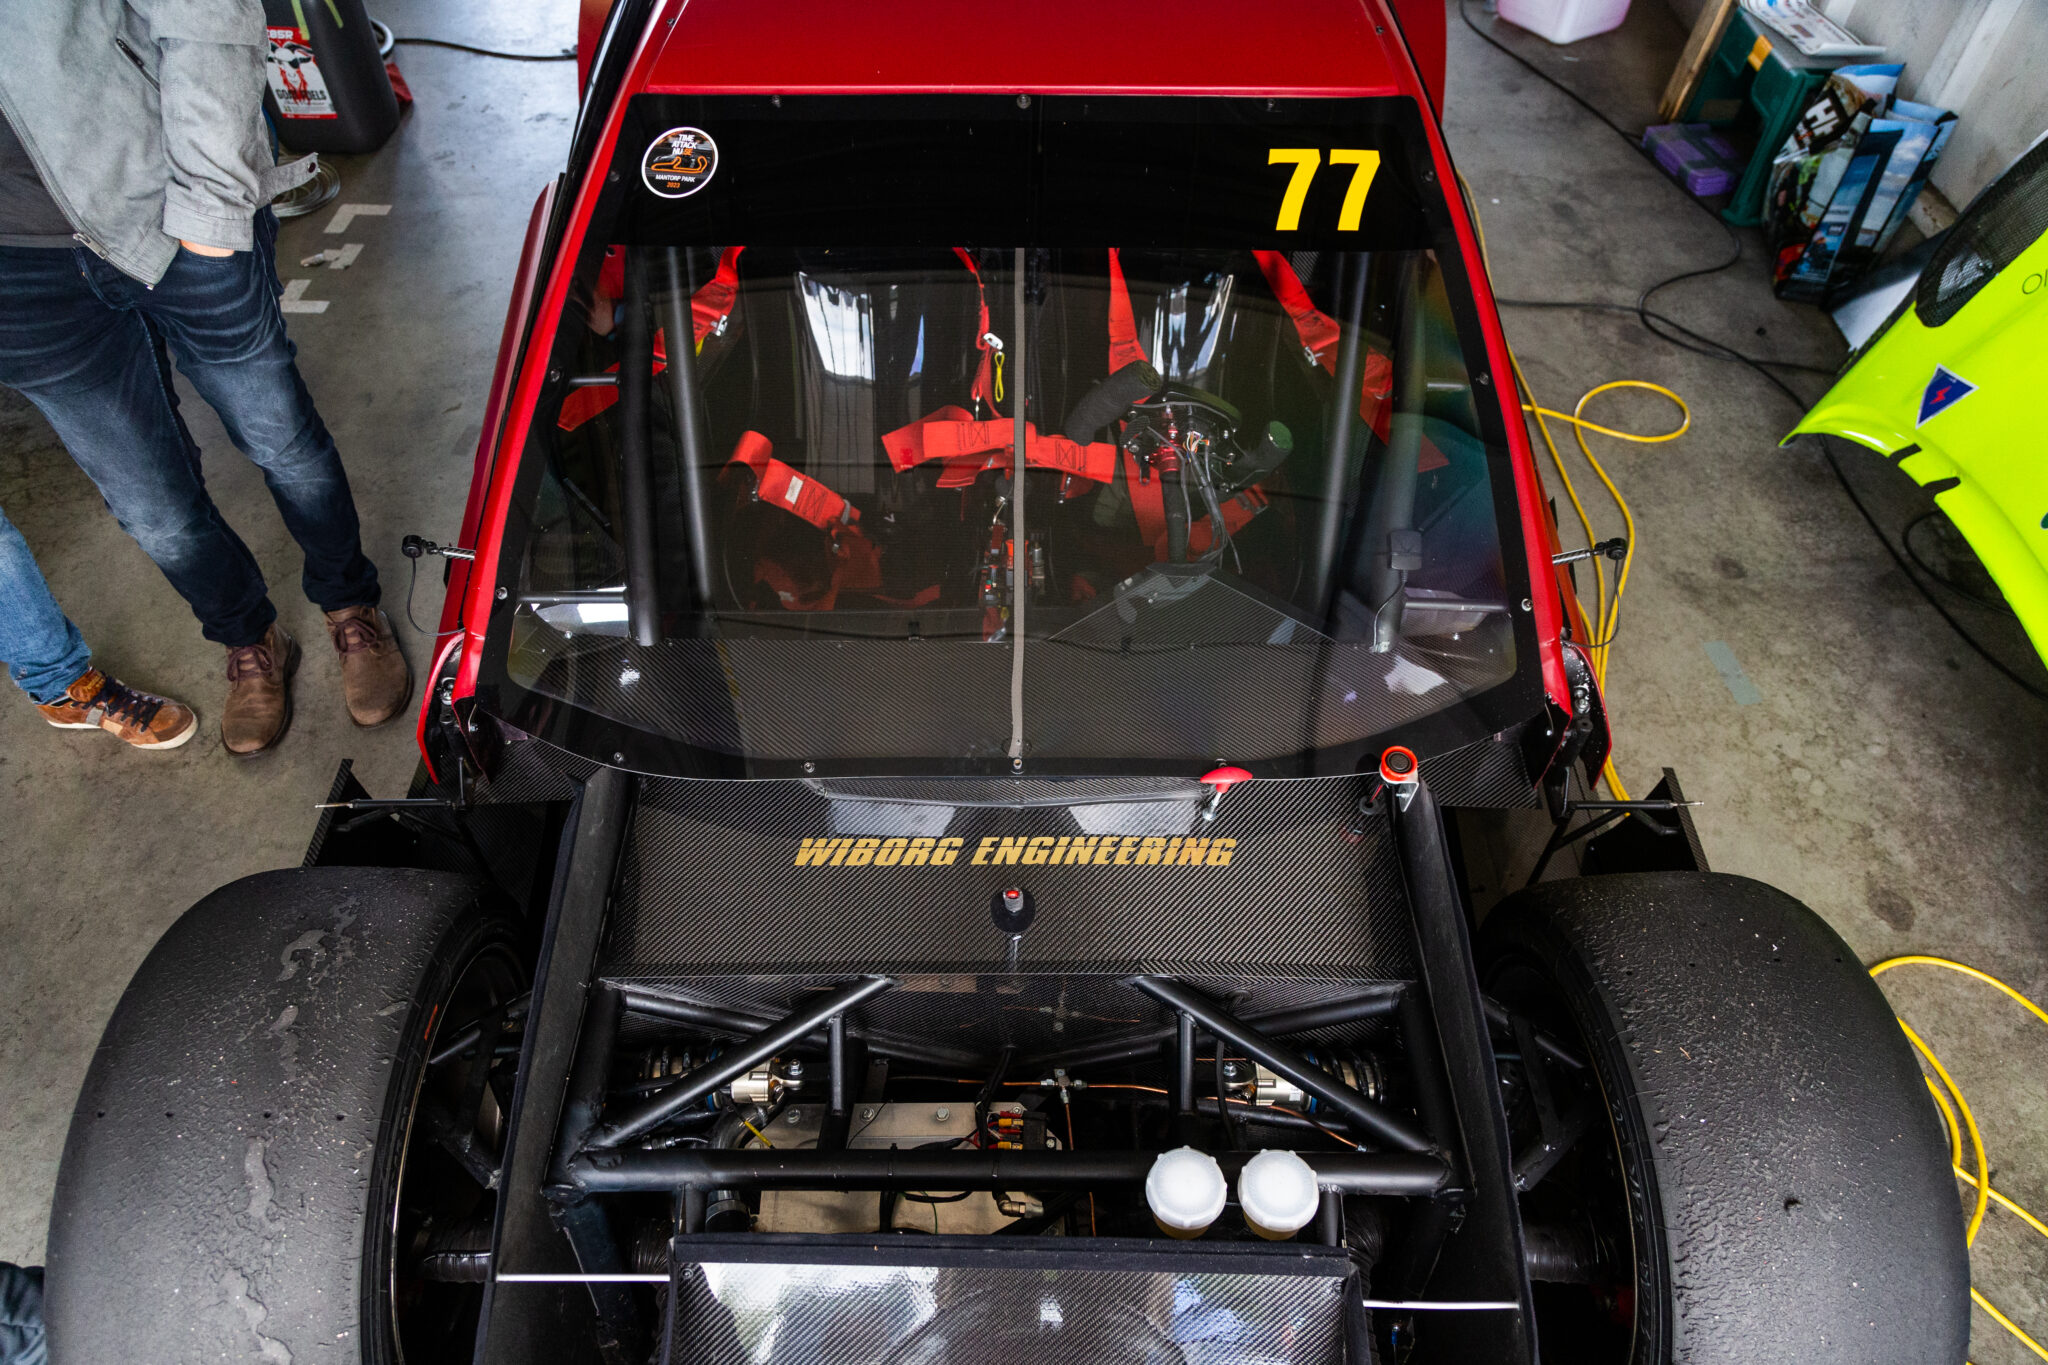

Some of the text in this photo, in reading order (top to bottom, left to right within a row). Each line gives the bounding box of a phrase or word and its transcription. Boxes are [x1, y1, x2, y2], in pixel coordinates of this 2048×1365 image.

[671, 141, 697, 149] ATTACK
[1268, 149, 1381, 231] 77
[794, 836, 1237, 866] WIBORG ENGINEERING
